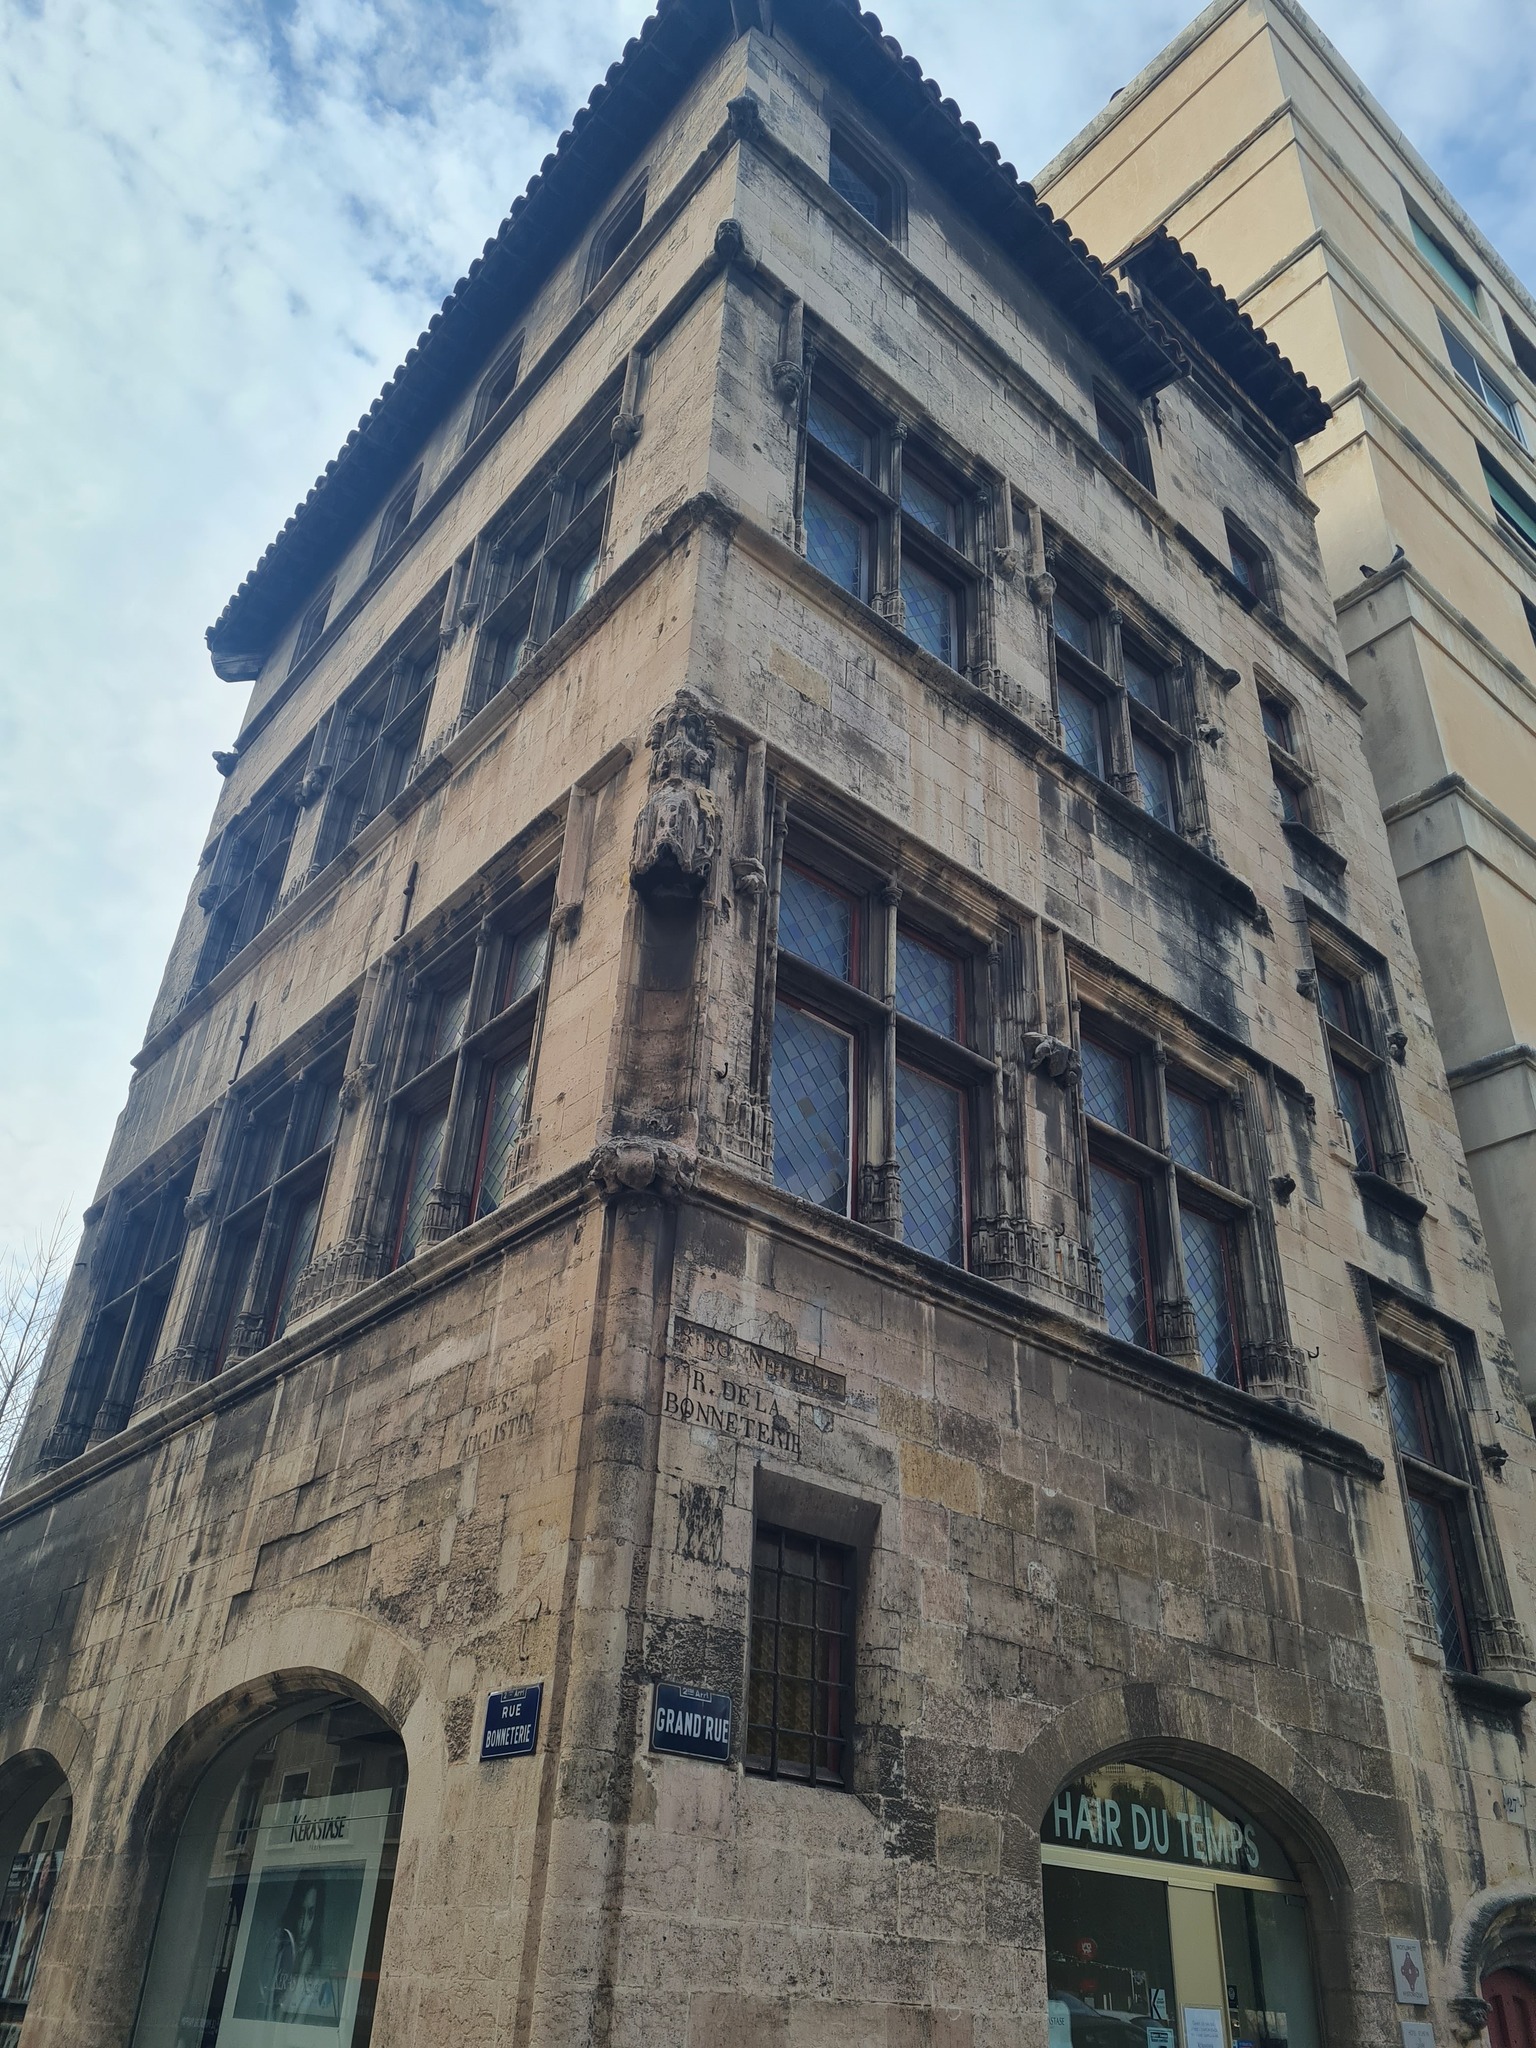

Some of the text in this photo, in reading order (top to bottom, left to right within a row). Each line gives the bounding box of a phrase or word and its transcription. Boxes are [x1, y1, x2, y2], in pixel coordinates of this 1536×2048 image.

[722, 1379, 750, 1408] DE
[755, 1391, 780, 1416] LA
[501, 1703, 522, 1719] RUE
[656, 1707, 729, 1744] GRAND'RUE
[485, 1724, 532, 1749] BONNETERIE
[1053, 1791, 1260, 1869] HAIR DU TEMPS
